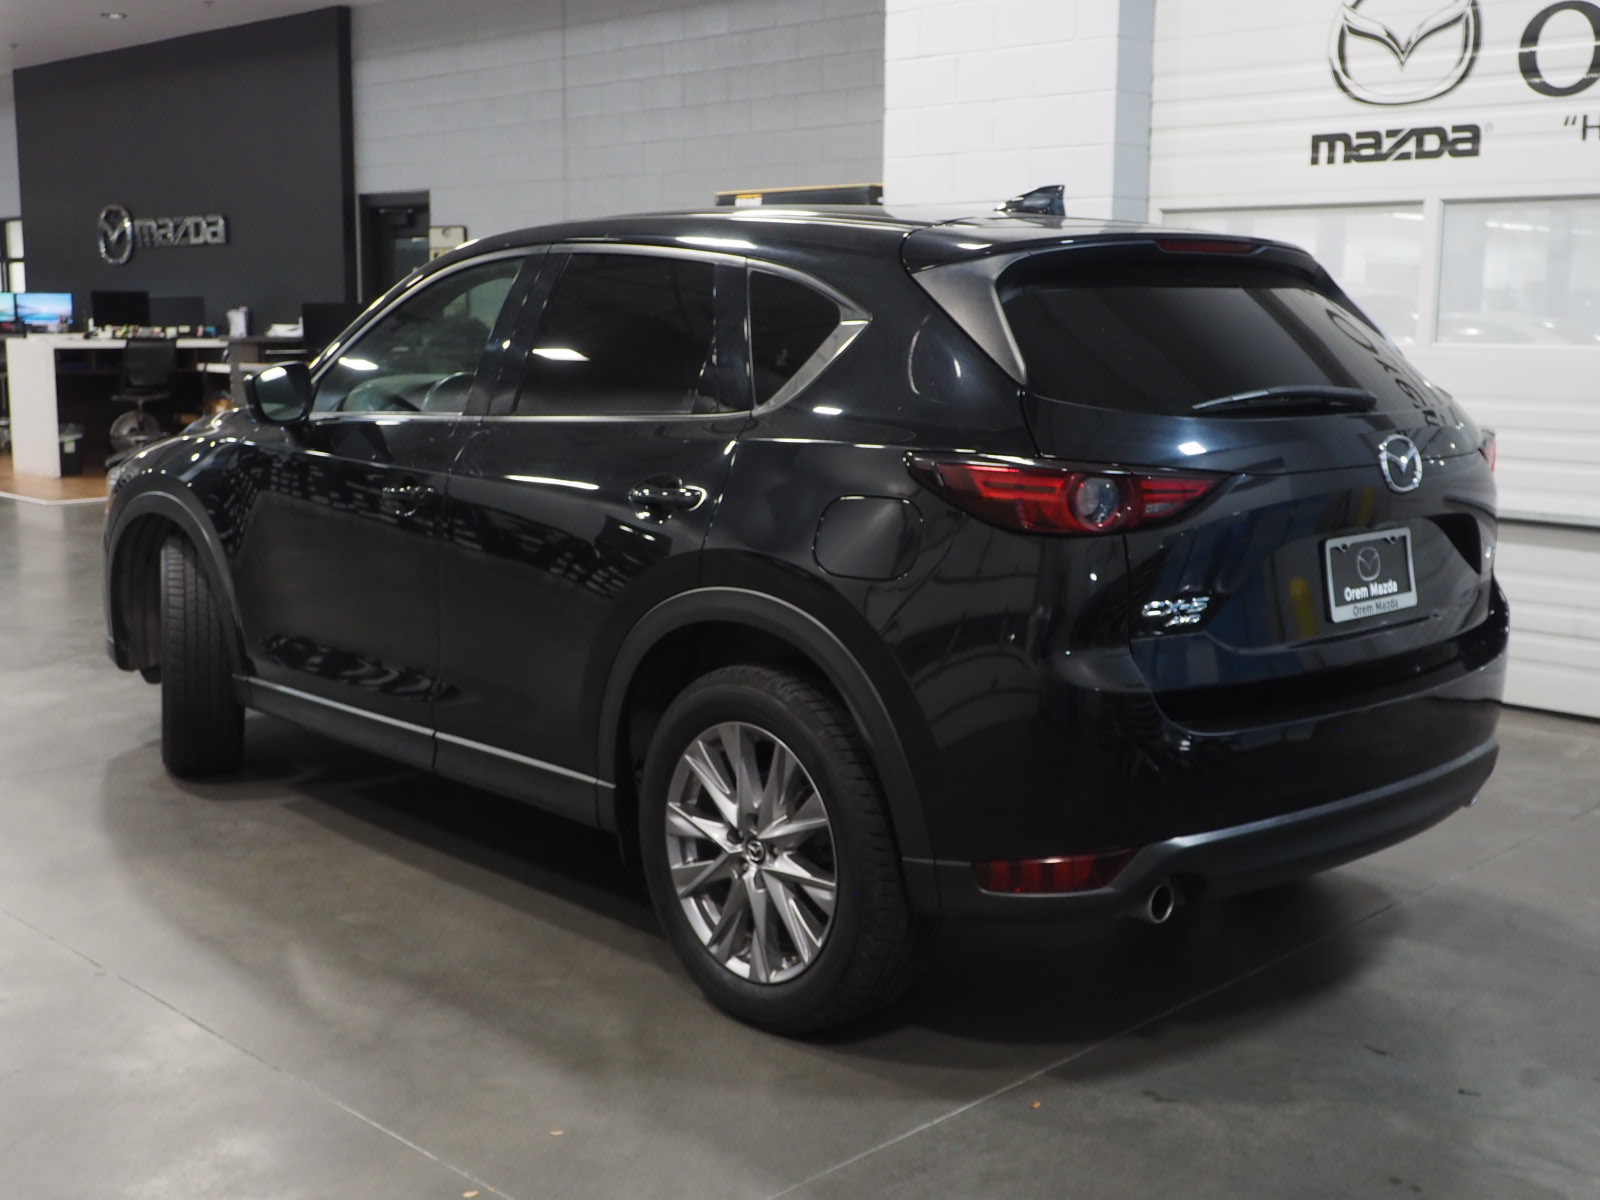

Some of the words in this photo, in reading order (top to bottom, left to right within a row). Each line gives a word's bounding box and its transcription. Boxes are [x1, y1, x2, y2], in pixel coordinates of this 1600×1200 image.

[1343, 586, 1369, 602] Orem
[1369, 579, 1398, 597] Mazda
[1142, 597, 1210, 617] CX-5
[1353, 604, 1374, 616] Orem
[1375, 598, 1399, 611] Mazda
